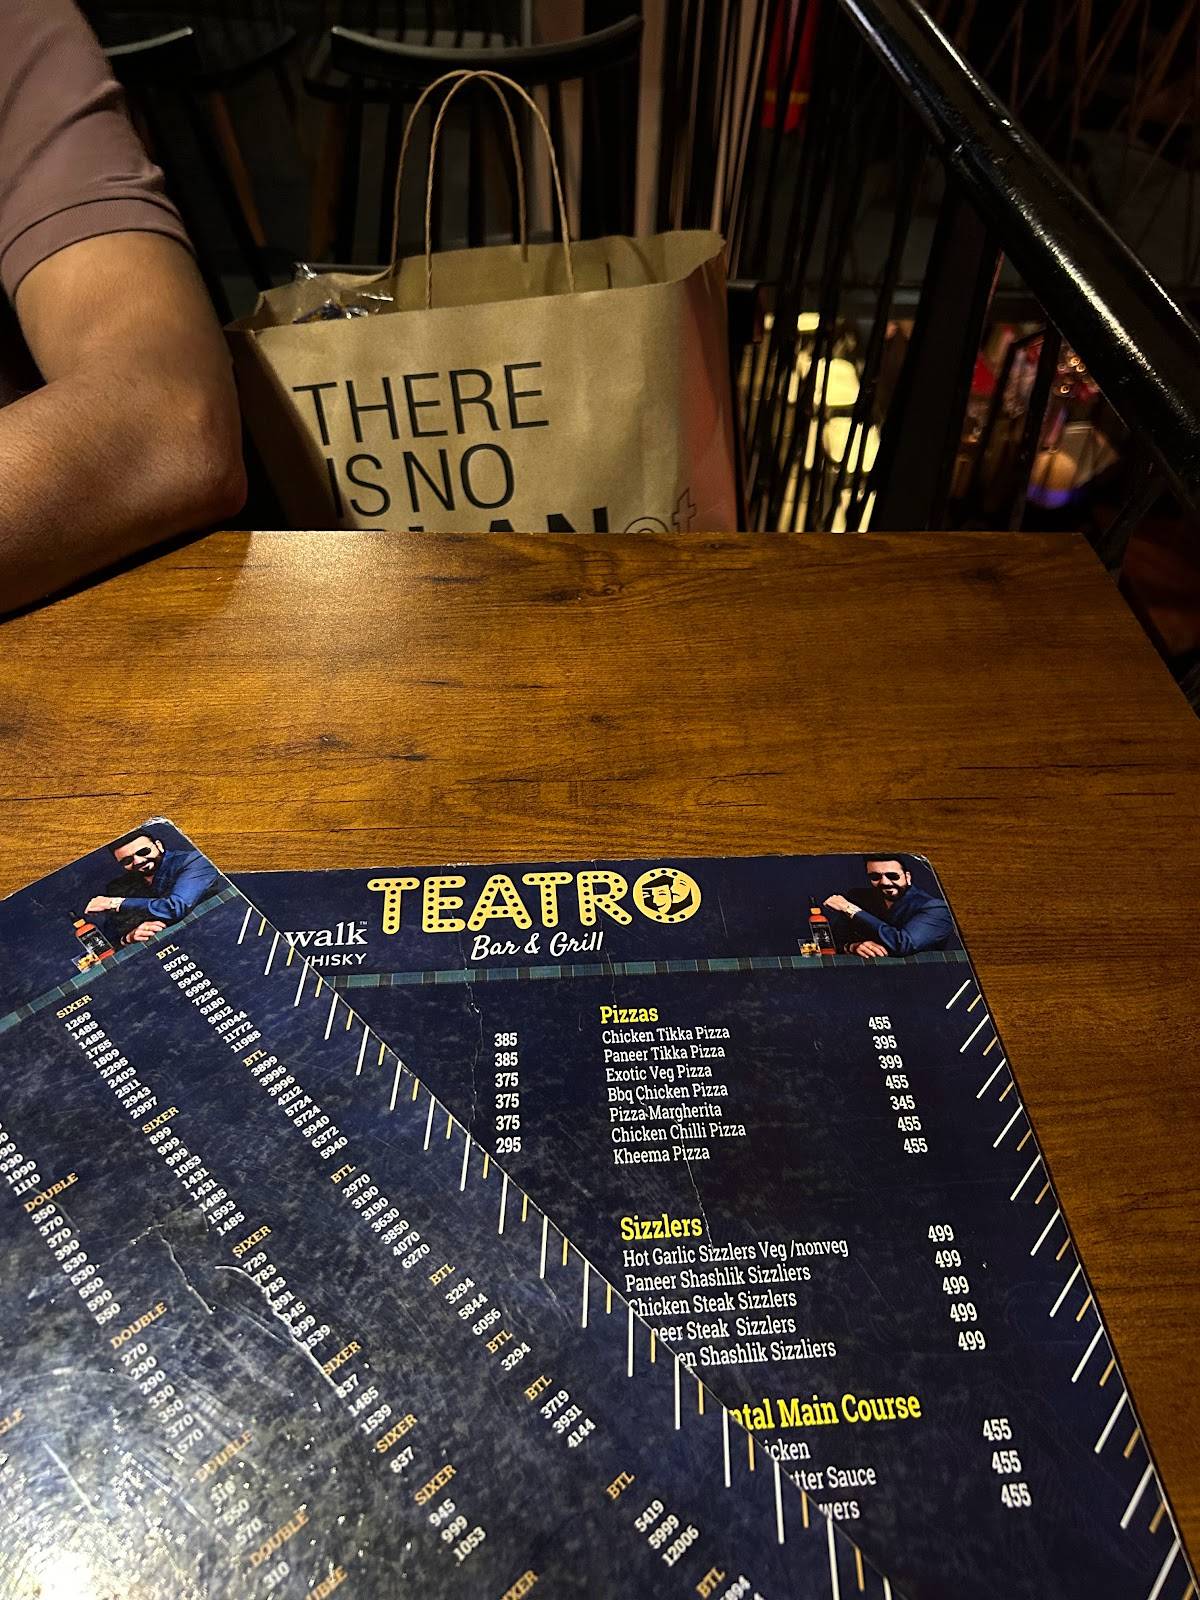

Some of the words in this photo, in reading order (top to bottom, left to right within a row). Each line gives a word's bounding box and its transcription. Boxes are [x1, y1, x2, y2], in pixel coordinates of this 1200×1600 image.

[292, 361, 549, 447] THERE
[325, 453, 391, 519] IS
[403, 443, 515, 513] NO
[367, 868, 701, 934] TEATRO
[284, 922, 368, 947] walk
[471, 935, 519, 960] Bar
[525, 933, 540, 953] &
[549, 931, 604, 957] Grill
[156, 944, 180, 960] BTL
[163, 954, 189, 972] 5076
[170, 962, 197, 981] 5940
[177, 971, 204, 989] 5940
[185, 979, 212, 998] 6999
[192, 988, 219, 1007] 7236
[56, 995, 93, 1019] SIXER
[200, 997, 226, 1016] 9180
[207, 1006, 234, 1025] 9612
[600, 1006, 658, 1024] Pizzas
[65, 1012, 92, 1032] 1269
[72, 1021, 99, 1041] 1485
[215, 1011, 248, 1034] 10044
[223, 1021, 254, 1043] 11772
[868, 1016, 891, 1031] 455
[230, 1030, 262, 1053] 11988
[494, 1033, 518, 1047] 385
[602, 1030, 654, 1044] Chicken
[657, 1028, 693, 1041] Tikka
[695, 1026, 730, 1039] Pizza
[872, 1035, 897, 1049] 395
[243, 1049, 268, 1067] BTL
[494, 1052, 518, 1067] 385
[604, 1049, 648, 1063] Paneer
[651, 1047, 688, 1060] Tikka
[690, 1045, 725, 1059] Pizza
[878, 1054, 902, 1069] 399
[100, 1057, 129, 1079] 2295
[251, 1056, 278, 1077] 3899
[259, 1065, 286, 1086] 3996
[606, 1068, 647, 1082] Exotic
[649, 1066, 674, 1082] Veg
[677, 1065, 712, 1078] Pizza
[108, 1067, 137, 1089] 2403
[115, 1079, 141, 1098] 2511
[495, 1073, 519, 1087] 375
[885, 1075, 909, 1089] 455
[123, 1087, 152, 1109] 2943
[277, 1085, 303, 1106] 4212
[495, 1094, 519, 1109] 375
[608, 1088, 634, 1104] Bbq
[636, 1084, 688, 1100] Chicken
[692, 1083, 728, 1097] Pizza
[890, 1095, 915, 1110] 345
[130, 1097, 159, 1119] 2997
[285, 1095, 313, 1117] 5724
[610, 1107, 647, 1122] Pizza
[648, 1104, 722, 1124] Margherita
[142, 1106, 179, 1134] SIXER
[302, 1115, 330, 1138] 5940
[496, 1115, 520, 1130] 375
[897, 1116, 921, 1132] 455
[150, 1127, 172, 1145] 899
[311, 1125, 340, 1148] 6372
[611, 1128, 667, 1143] Chicken
[670, 1124, 707, 1140] Chilli
[710, 1123, 746, 1138] Pizza
[157, 1137, 180, 1156] 999
[320, 1136, 348, 1159] 5940
[496, 1137, 521, 1153] 295
[613, 1148, 670, 1164] Kheema
[673, 1146, 710, 1161] Pizza
[903, 1138, 928, 1153] 455
[6, 1160, 37, 1185] 1090
[174, 1155, 202, 1178] 1053
[330, 1163, 356, 1184] BTL
[13, 1174, 41, 1196] 1110
[182, 1168, 210, 1190] 1431
[342, 1173, 371, 1198] 2970
[24, 1172, 78, 1213] DOUBLE
[199, 1189, 228, 1212] 1485
[351, 1185, 379, 1209] 3190
[31, 1204, 56, 1225] 350
[208, 1200, 236, 1224] 1593
[361, 1197, 388, 1221] 3190
[371, 1207, 400, 1233] 3630
[39, 1215, 64, 1237] 370
[216, 1211, 245, 1237] 1485
[381, 1220, 410, 1245] 3850
[621, 1214, 702, 1241] Sizzlers
[928, 1224, 954, 1243] 499
[47, 1228, 72, 1249] 370
[232, 1225, 272, 1256] SIXER
[393, 1231, 420, 1256] 4070
[55, 1240, 80, 1262] 390
[402, 1243, 430, 1269] 6270
[623, 1249, 650, 1268] Hot
[653, 1247, 695, 1265] Garlic
[699, 1244, 756, 1262] Sizzlers
[758, 1241, 787, 1261] Veg
[935, 1250, 962, 1268] 499
[62, 1252, 88, 1274] 530
[243, 1252, 267, 1273] 729
[70, 1264, 95, 1286] 530
[429, 1263, 456, 1287] BTL
[626, 1273, 677, 1292] Paneer
[680, 1268, 745, 1288] Shashlik
[748, 1265, 811, 1284] Sizzliers
[942, 1275, 970, 1295] 499
[445, 1278, 475, 1304] 3294
[458, 1293, 488, 1320] 5844
[628, 1299, 690, 1317] Chicken
[694, 1295, 735, 1312] Steak
[738, 1290, 797, 1309] Sizzlers
[949, 1303, 977, 1323] 499
[110, 1302, 168, 1350] DOUBLE
[472, 1308, 501, 1336] 6056
[687, 1321, 728, 1341] Steak
[738, 1318, 796, 1336] Sizzlers
[485, 1329, 513, 1354] BTL
[958, 1330, 986, 1351] 499
[501, 1342, 532, 1371] 3294
[700, 1346, 768, 1368] Shashlik
[771, 1341, 837, 1361] Sizzliers
[524, 1375, 553, 1401] BTL
[348, 1386, 379, 1417] 1485
[540, 1390, 570, 1419] 3719
[778, 1393, 840, 1428] Main
[841, 1393, 922, 1423] Course
[361, 1404, 392, 1435] 1539
[552, 1405, 582, 1434] 3931
[982, 1418, 1012, 1441] 455
[376, 1413, 418, 1453] SIXER
[567, 1418, 596, 1448] 4144
[992, 1450, 1021, 1474] 455
[415, 1464, 457, 1506] SIXER
[606, 1471, 635, 1499] BTL
[827, 1466, 876, 1489] Sauce
[1001, 1482, 1032, 1508] 455
[429, 1498, 456, 1527] 945
[634, 1500, 664, 1532] 5419
[441, 1515, 468, 1544] 999
[648, 1514, 679, 1549] 5999
[453, 1526, 487, 1562] 1053
